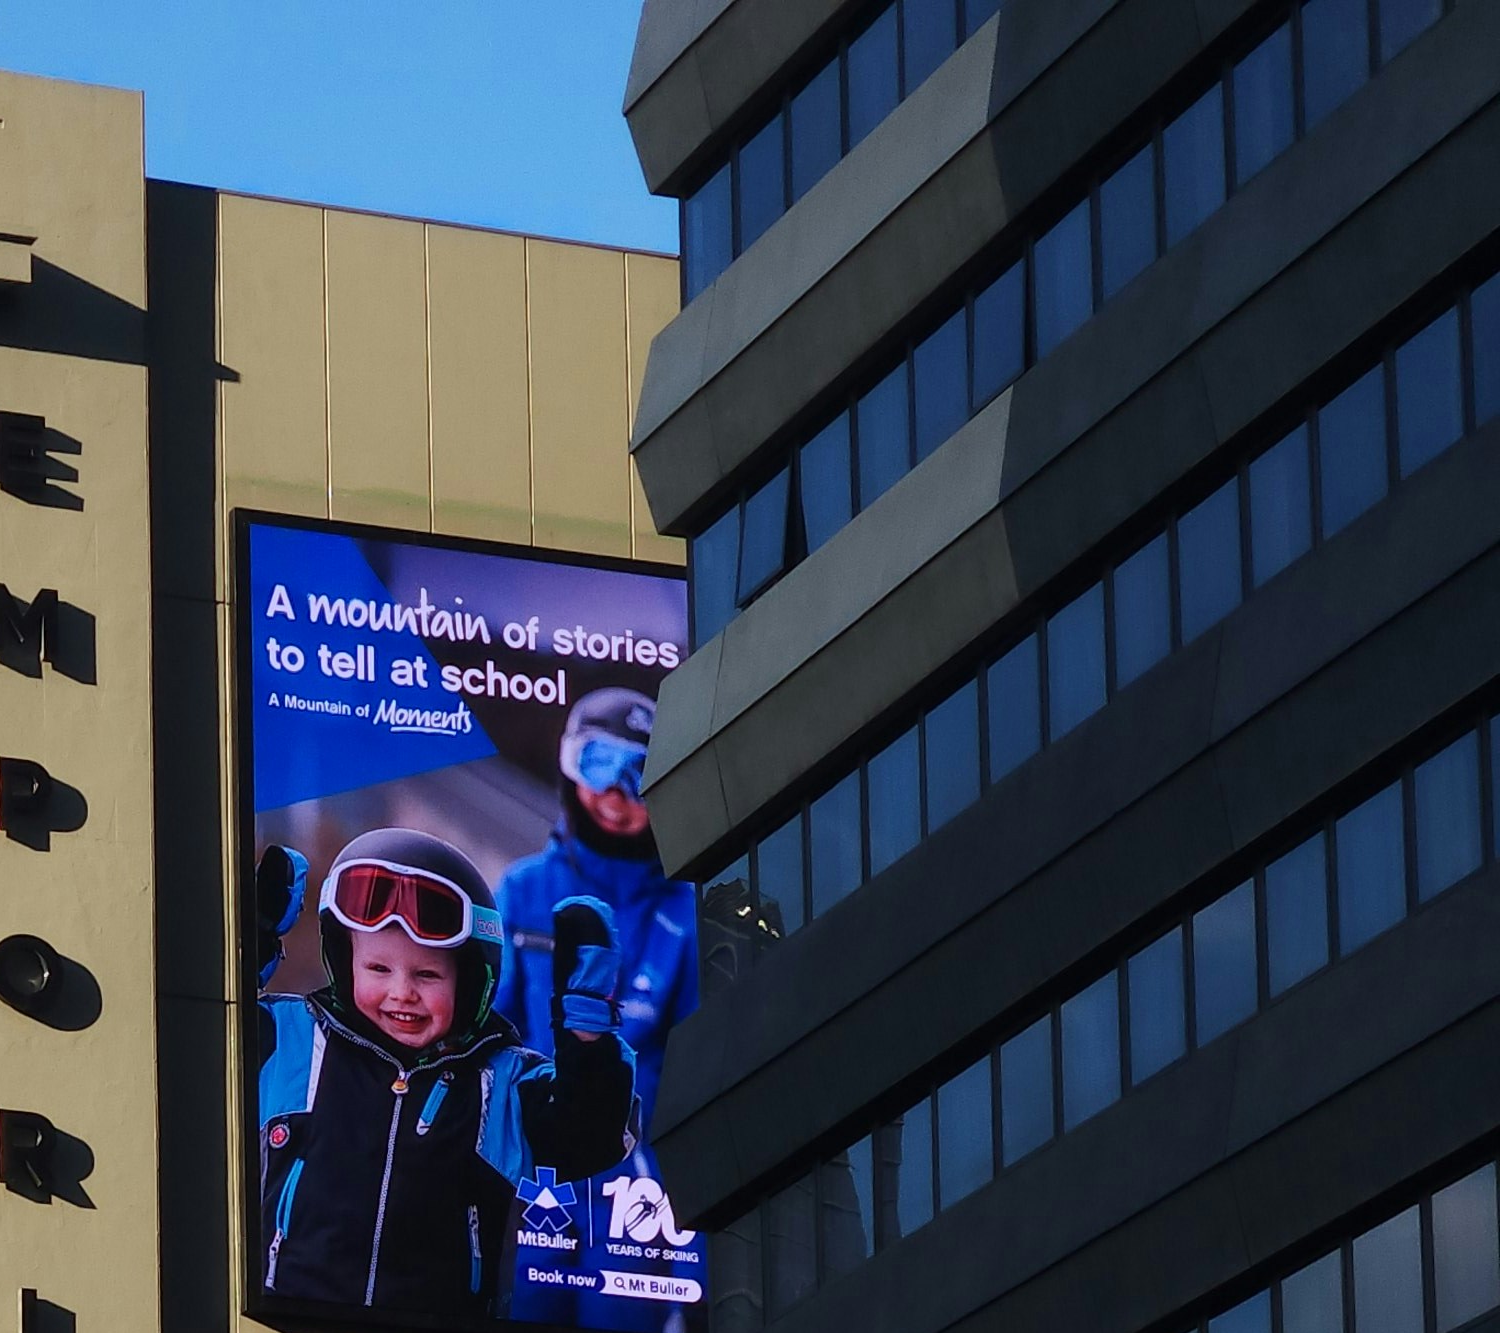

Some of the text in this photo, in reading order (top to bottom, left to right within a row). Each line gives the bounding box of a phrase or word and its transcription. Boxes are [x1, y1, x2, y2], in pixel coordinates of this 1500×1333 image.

[266, 584, 680, 669] A mountain of stories
[266, 636, 567, 705] to tell at school
[268, 692, 473, 734] A Mountain of Moments
[606, 1243, 699, 1263] YEARS OF SKIING
[528, 1267, 597, 1287] Book now
[629, 1279, 646, 1292] Mt
